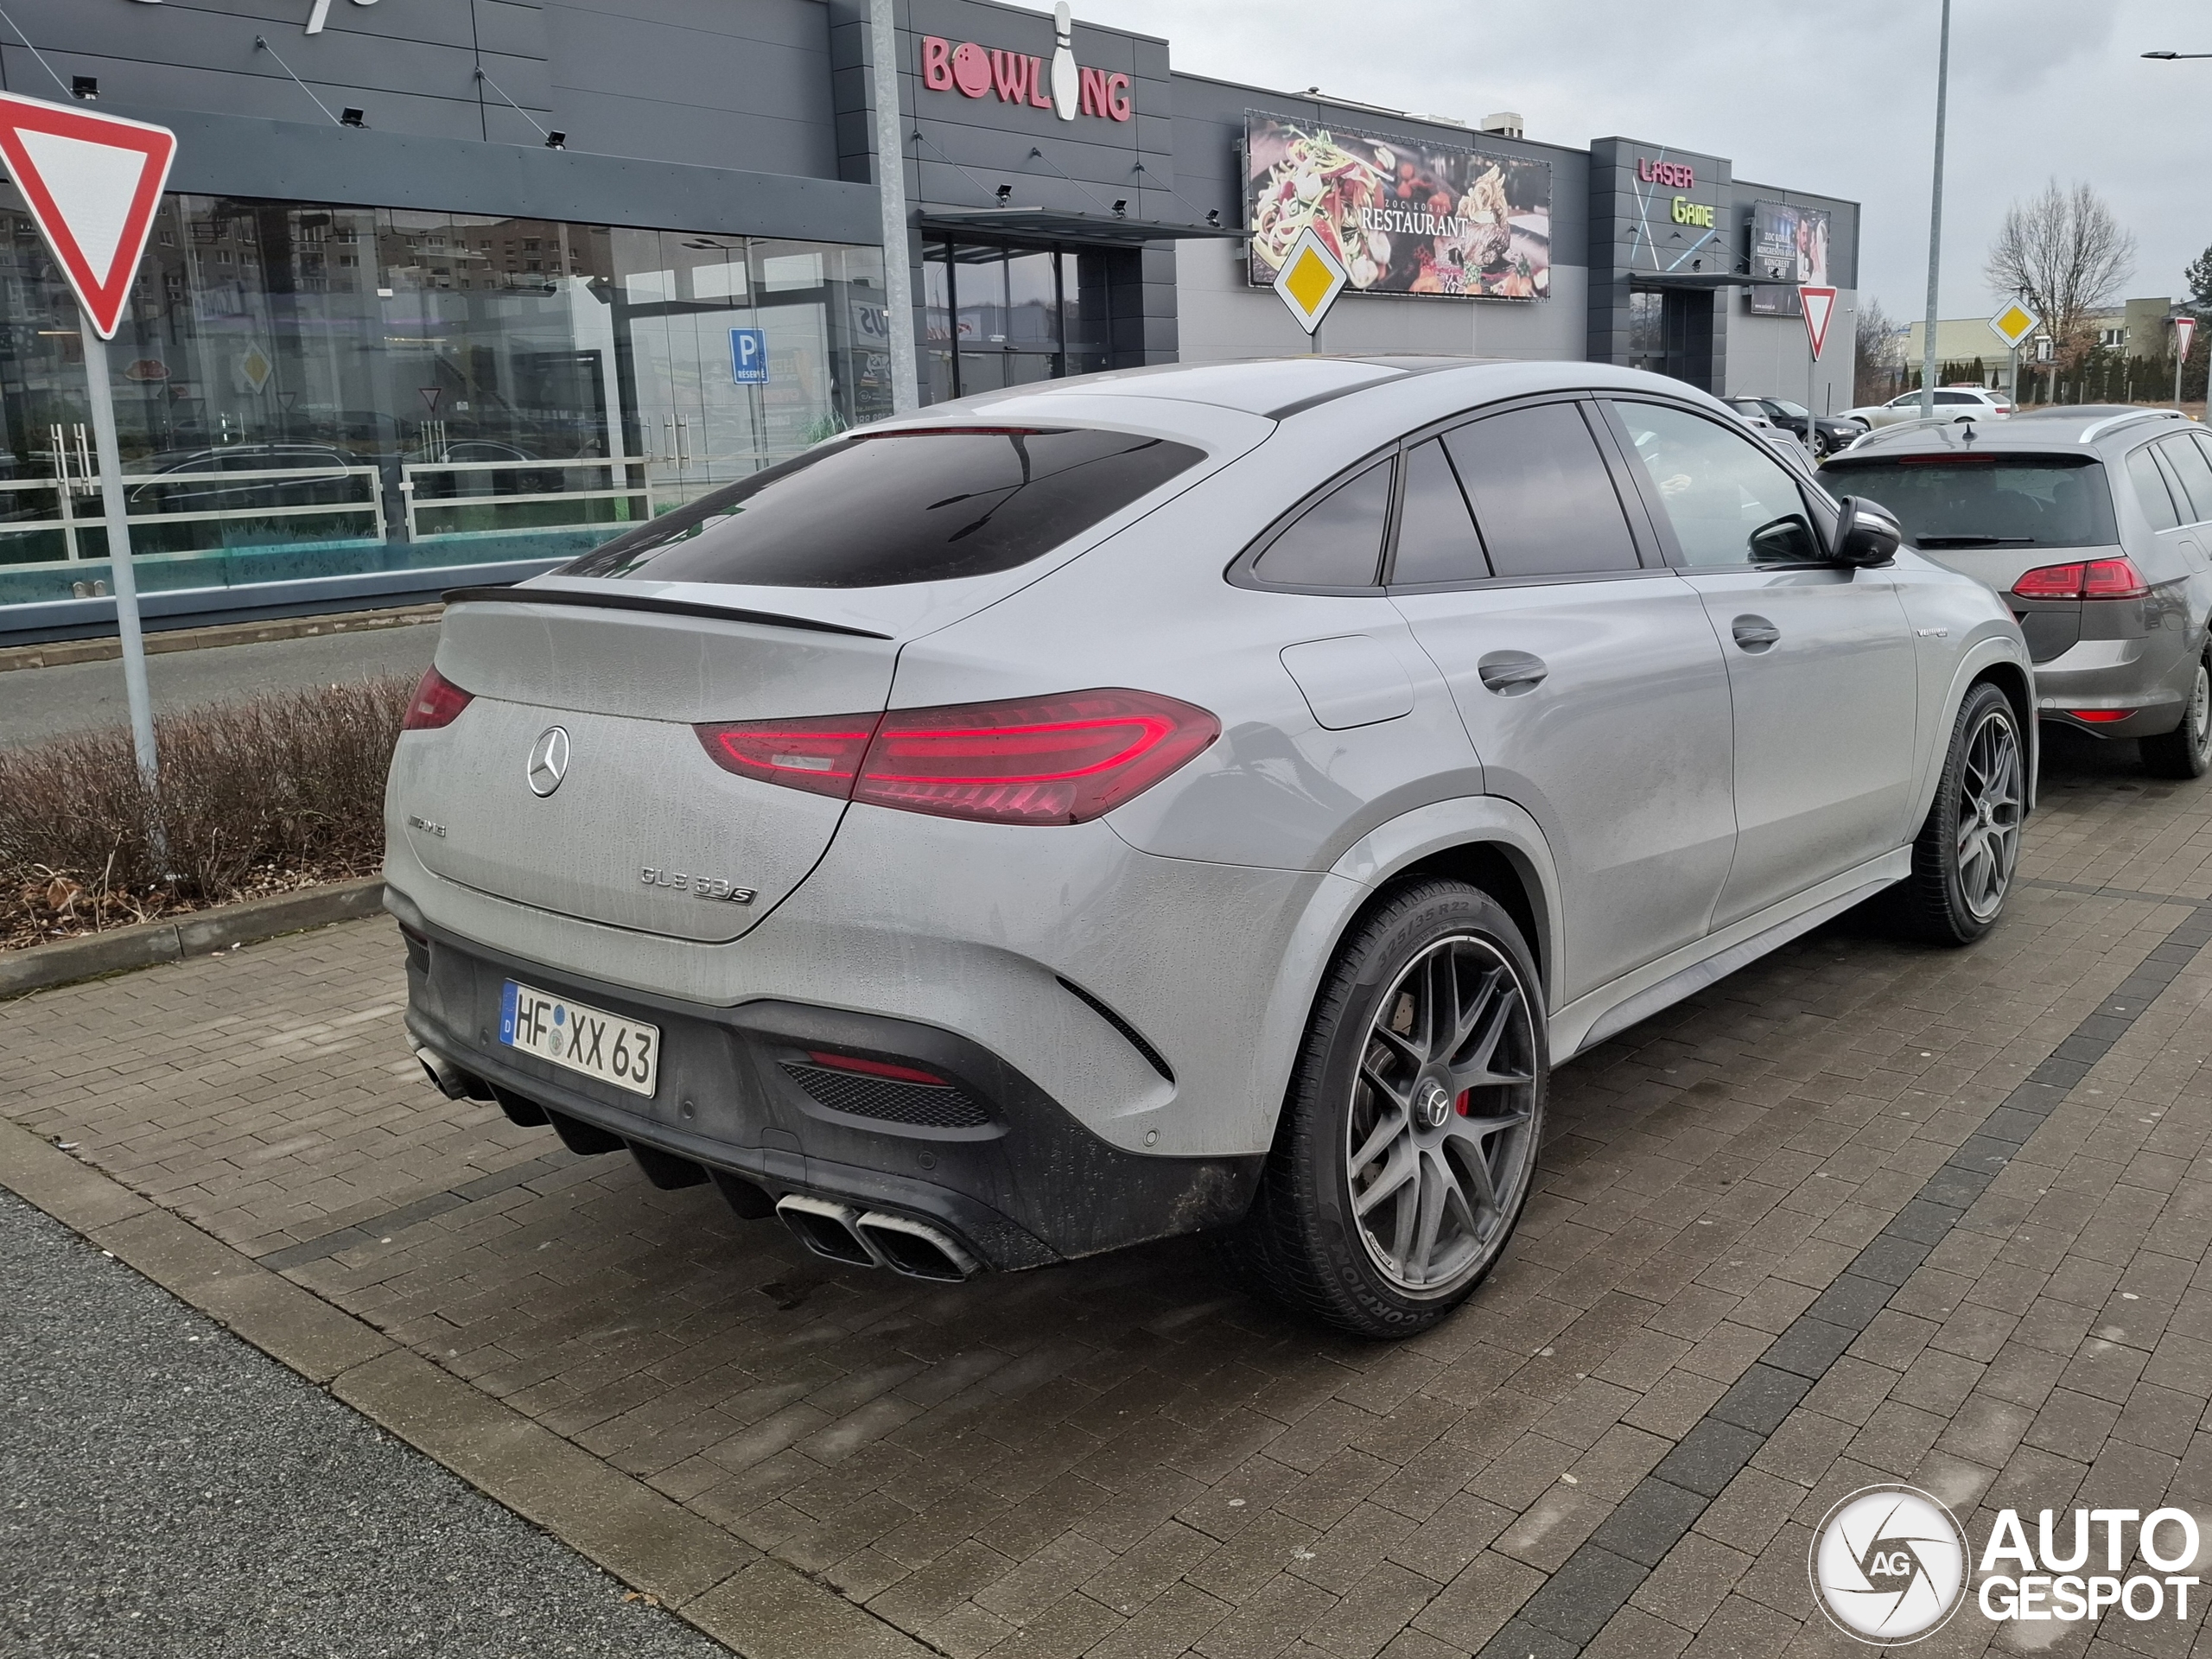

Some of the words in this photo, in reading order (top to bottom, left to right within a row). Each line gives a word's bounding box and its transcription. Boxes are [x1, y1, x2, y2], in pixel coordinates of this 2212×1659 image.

[923, 2, 1130, 121] BOWLING
[1638, 157, 1694, 188] LASER
[1384, 199, 1406, 209] ZOC
[1414, 202, 1447, 213] KORAL
[1671, 196, 1713, 227] GAME
[1361, 207, 1468, 238] RESTAURANT
[1764, 232, 1775, 241] ZOC
[740, 335, 755, 365] P
[641, 866, 688, 891] GLE
[1378, 907, 1434, 968] 325/35
[504, 1019, 512, 1033] D
[515, 994, 551, 1046] HF
[567, 1011, 606, 1071] XX
[612, 1027, 652, 1084] 63
[1332, 1244, 1434, 1326] SCORPION
